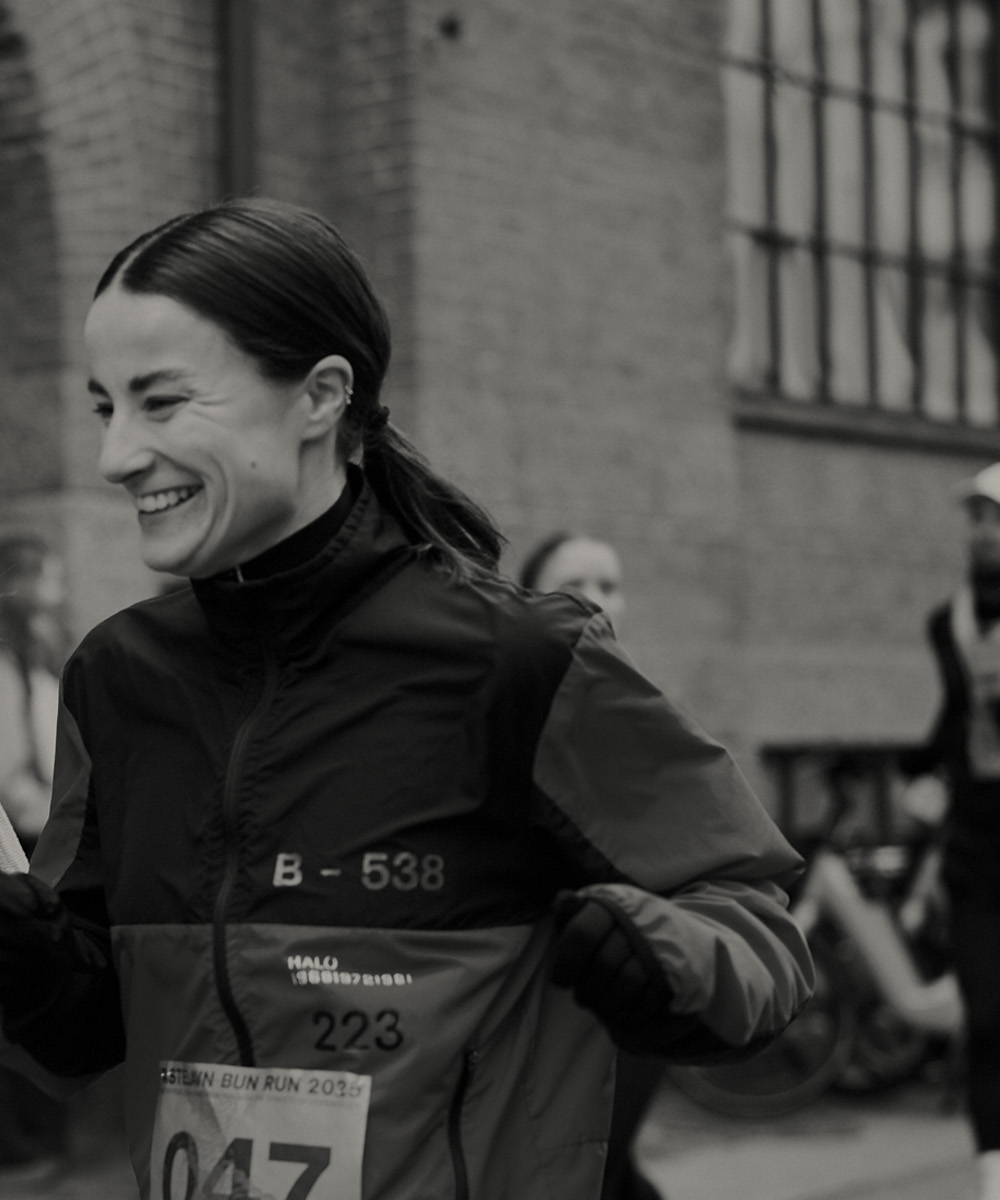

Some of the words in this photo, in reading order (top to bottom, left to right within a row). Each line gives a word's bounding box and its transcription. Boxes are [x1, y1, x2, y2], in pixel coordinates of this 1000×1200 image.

[272, 851, 303, 888] B
[361, 851, 446, 892] 538
[287, 954, 339, 971] HALO
[311, 1008, 405, 1053] 223
[220, 1072, 260, 1091] BUN
[262, 1074, 301, 1093] RUN
